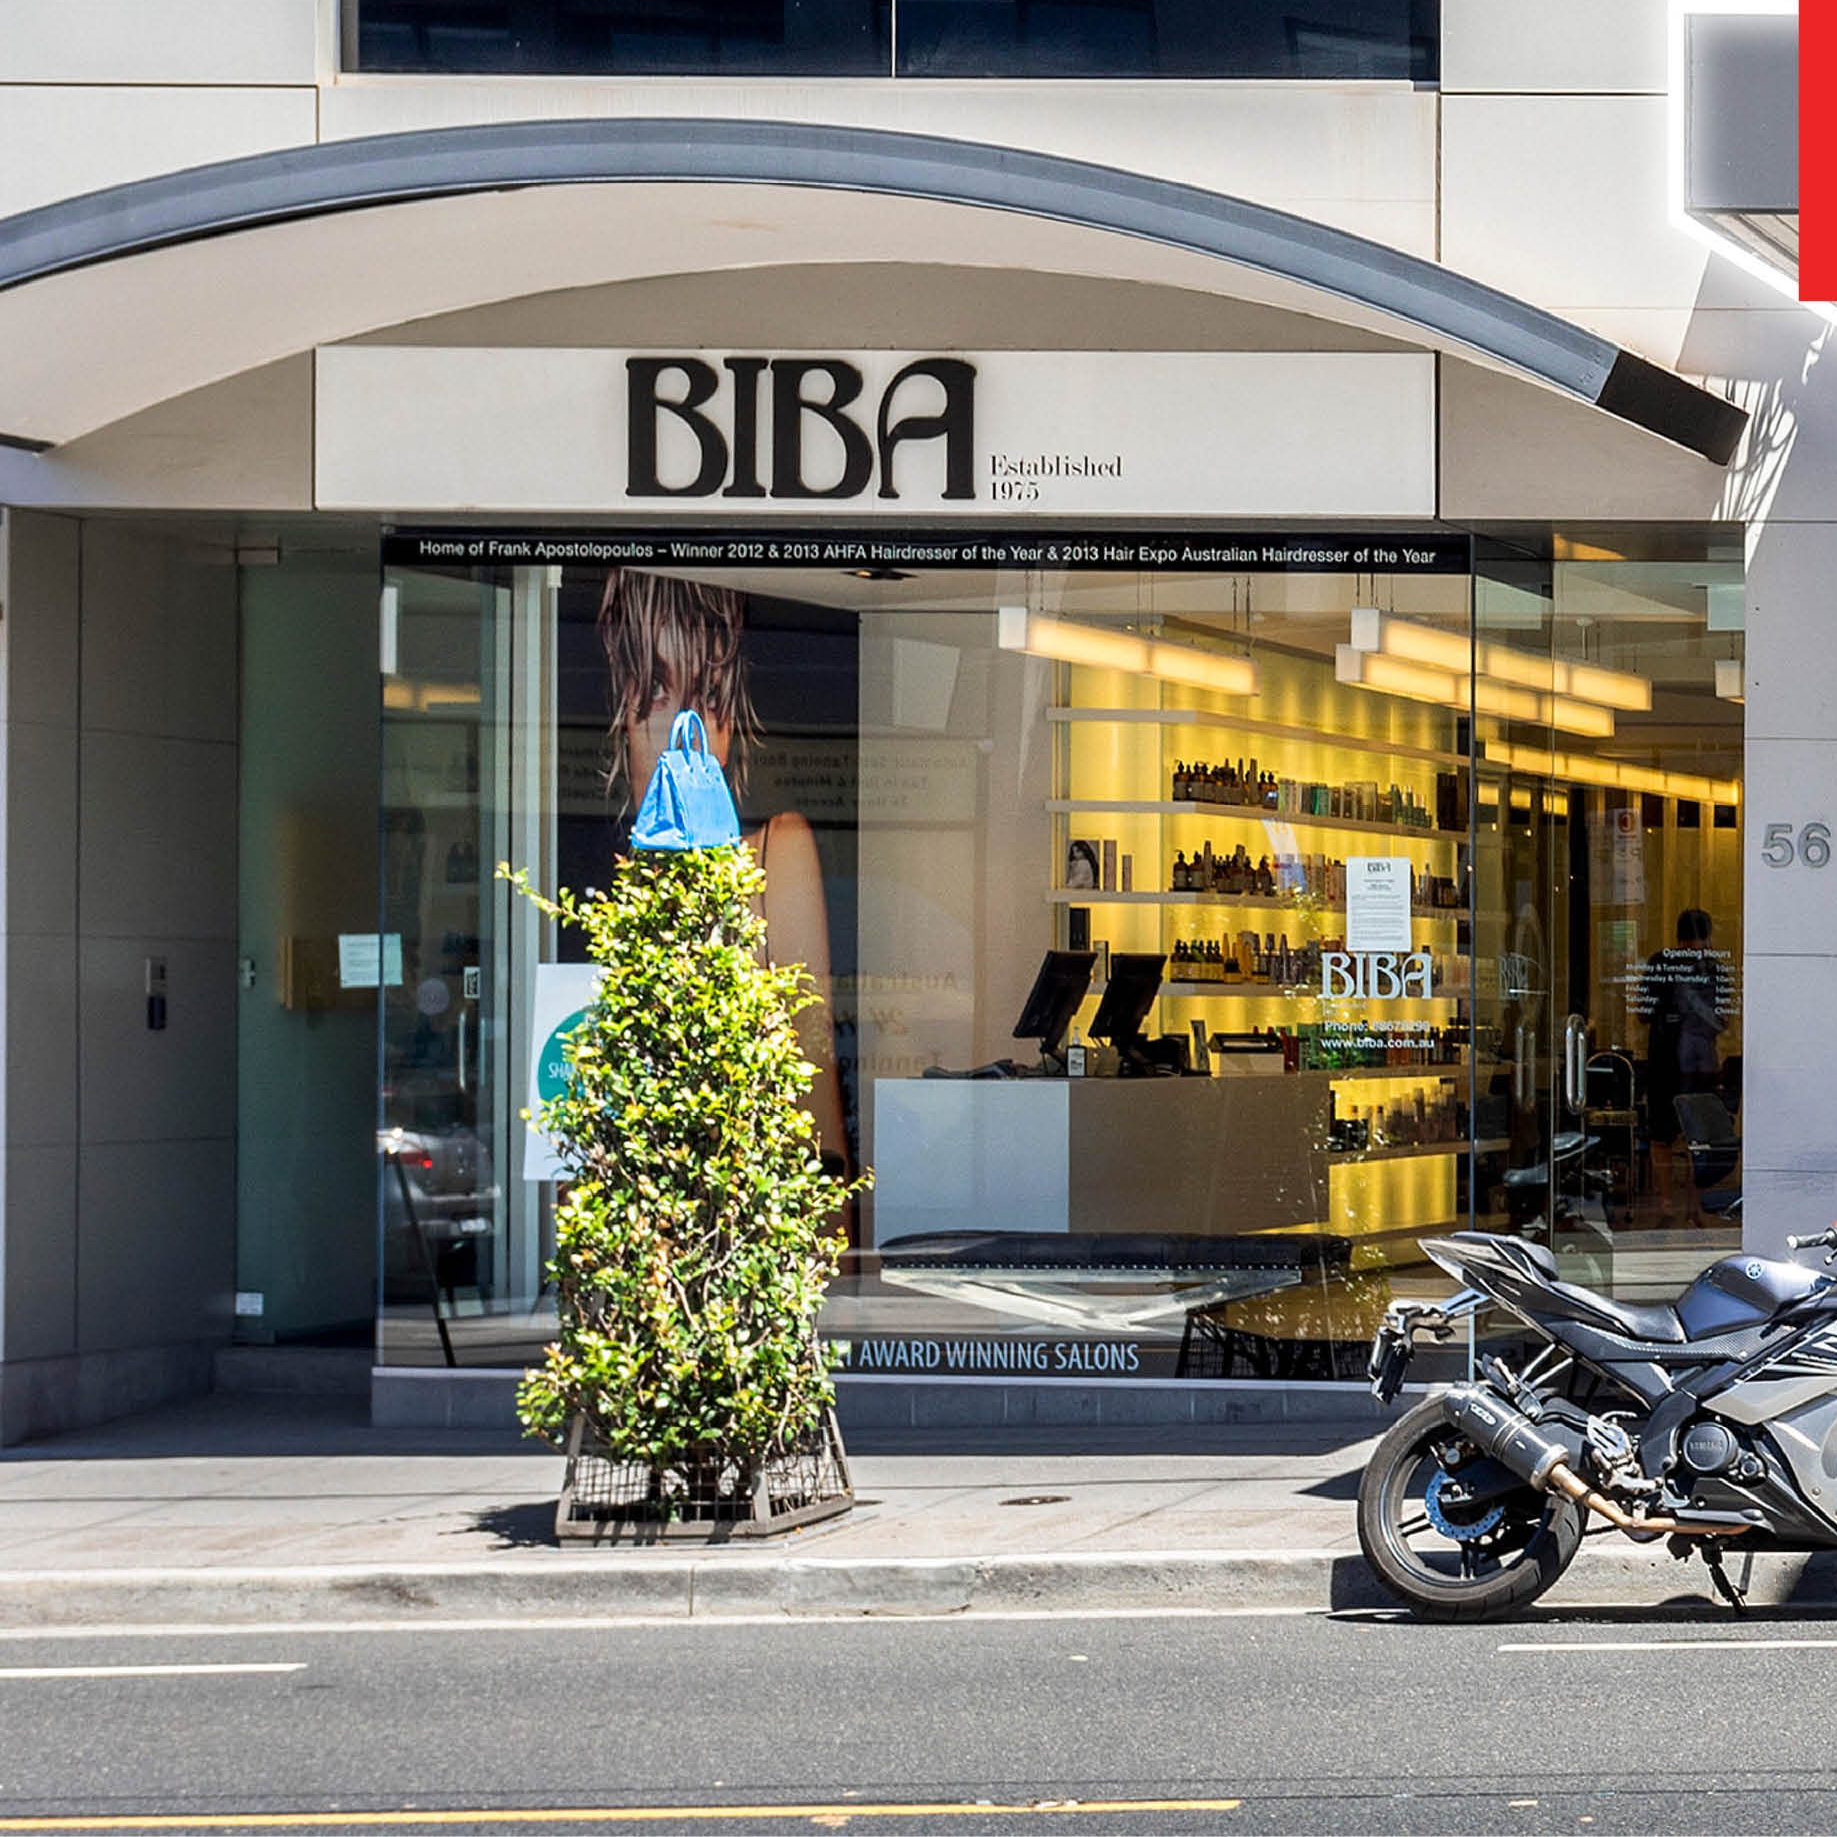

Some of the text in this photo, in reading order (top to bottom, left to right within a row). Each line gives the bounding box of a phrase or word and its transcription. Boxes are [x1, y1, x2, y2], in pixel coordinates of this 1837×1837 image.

[625, 357, 977, 500] BIBA
[991, 454, 1123, 477] Established
[992, 481, 1040, 501] 1975
[421, 541, 464, 555] Home
[469, 541, 485, 555] of
[489, 541, 530, 555] Frank
[535, 542, 653, 559] Apostolopoulos
[671, 543, 723, 557] Winner
[728, 544, 763, 558] 2012
[768, 544, 780, 558] &
[784, 544, 819, 558] 2013
[824, 545, 867, 558] AHFA
[871, 544, 957, 559] Hairdresser
[962, 545, 979, 559] of
[982, 546, 1007, 560] the
[1011, 546, 1043, 560] Year
[1047, 546, 1059, 560] &
[1063, 546, 1098, 560] 2013
[1103, 546, 1134, 560] Hair
[1139, 546, 1178, 564] Expo
[1182, 547, 1258, 561] Australian
[1262, 548, 1349, 562] Hairdresser
[1354, 548, 1370, 562] of
[1373, 549, 1398, 563] the
[1402, 549, 1436, 563] Year
[1761, 822, 1833, 868] 56
[1662, 945, 1732, 959] Opening Hours
[1318, 952, 1433, 1000] BIBA
[1320, 1036, 1435, 1049] www.biba.com.au
[859, 1339, 941, 1368] AWARD
[945, 1339, 1048, 1370] WINNING
[1054, 1338, 1141, 1371] SALONS
